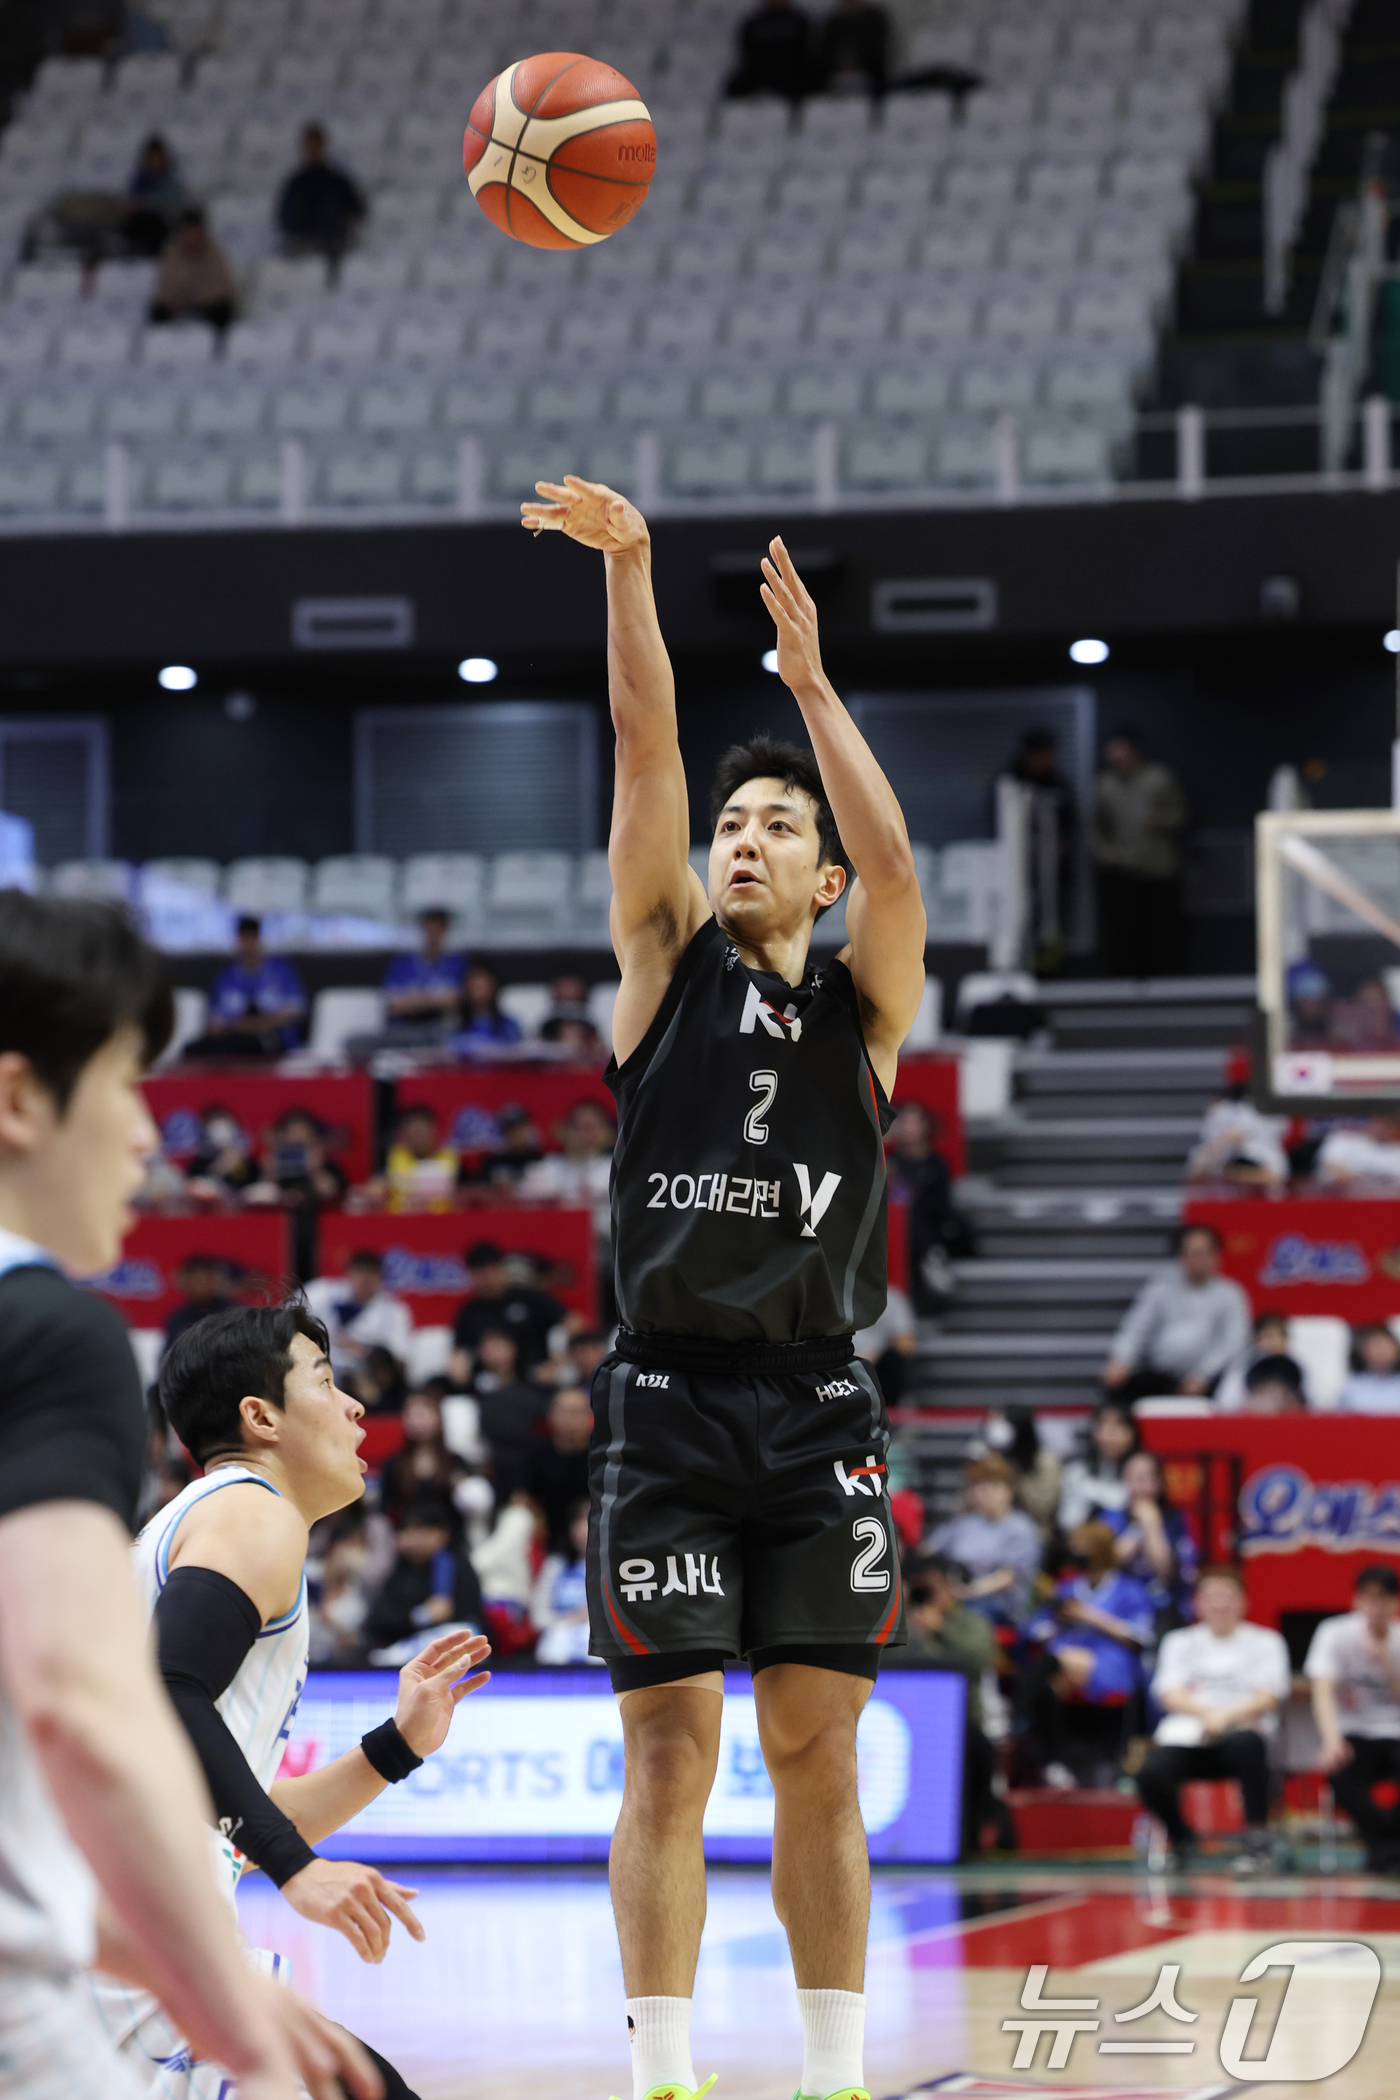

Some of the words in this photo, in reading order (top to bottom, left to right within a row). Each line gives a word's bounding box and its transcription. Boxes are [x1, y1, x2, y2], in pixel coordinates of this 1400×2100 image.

[618, 143, 656, 163] molte
[743, 1069, 779, 1145] 2
[646, 1172, 781, 1218] 20대라면
[635, 1372, 670, 1389] KBL
[618, 1553, 726, 1603] 유사나
[849, 1516, 891, 1593] 2
